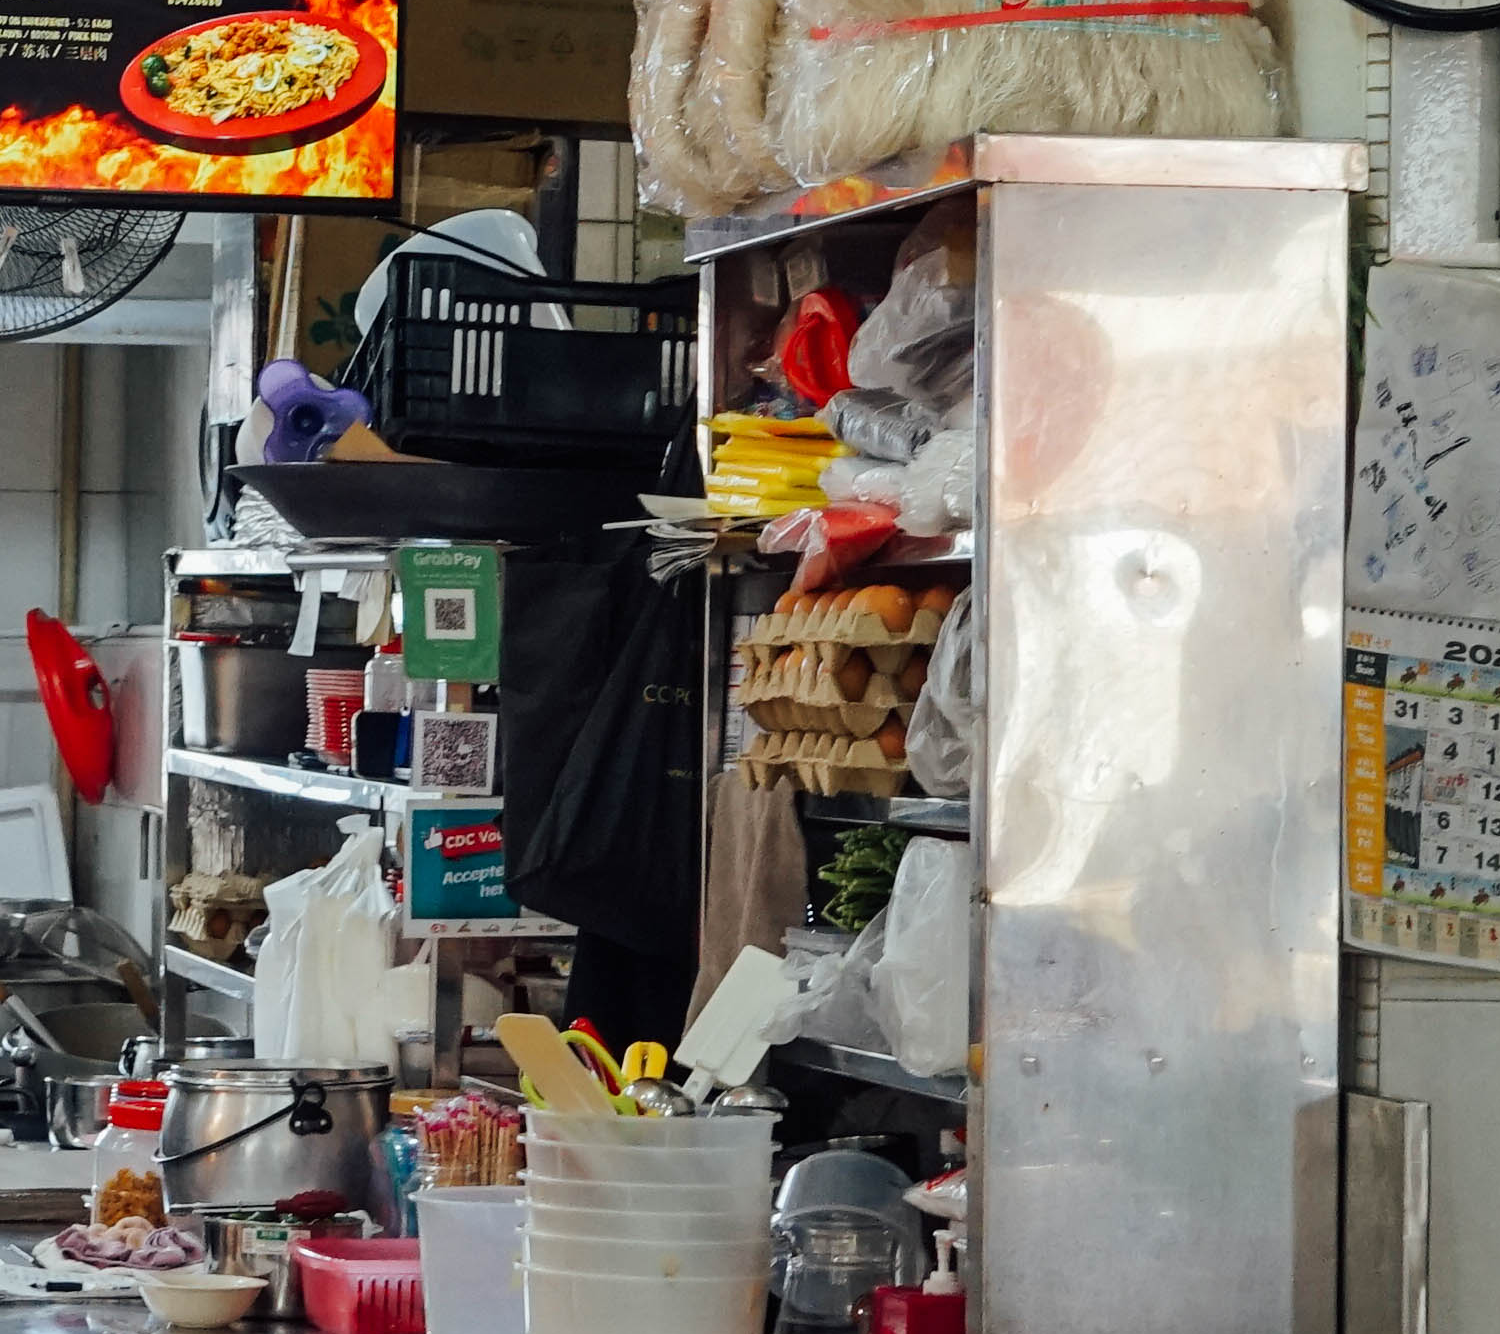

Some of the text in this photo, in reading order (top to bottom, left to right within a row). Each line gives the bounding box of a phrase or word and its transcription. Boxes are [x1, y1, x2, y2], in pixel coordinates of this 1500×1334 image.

[413, 552, 482, 569] GrabPay
[1394, 700, 1419, 720] 31
[1449, 707, 1463, 725] 3
[1443, 742, 1459, 760] 4
[1437, 811, 1450, 830] 6
[446, 834, 475, 849] CDC
[1435, 846, 1448, 864] 7
